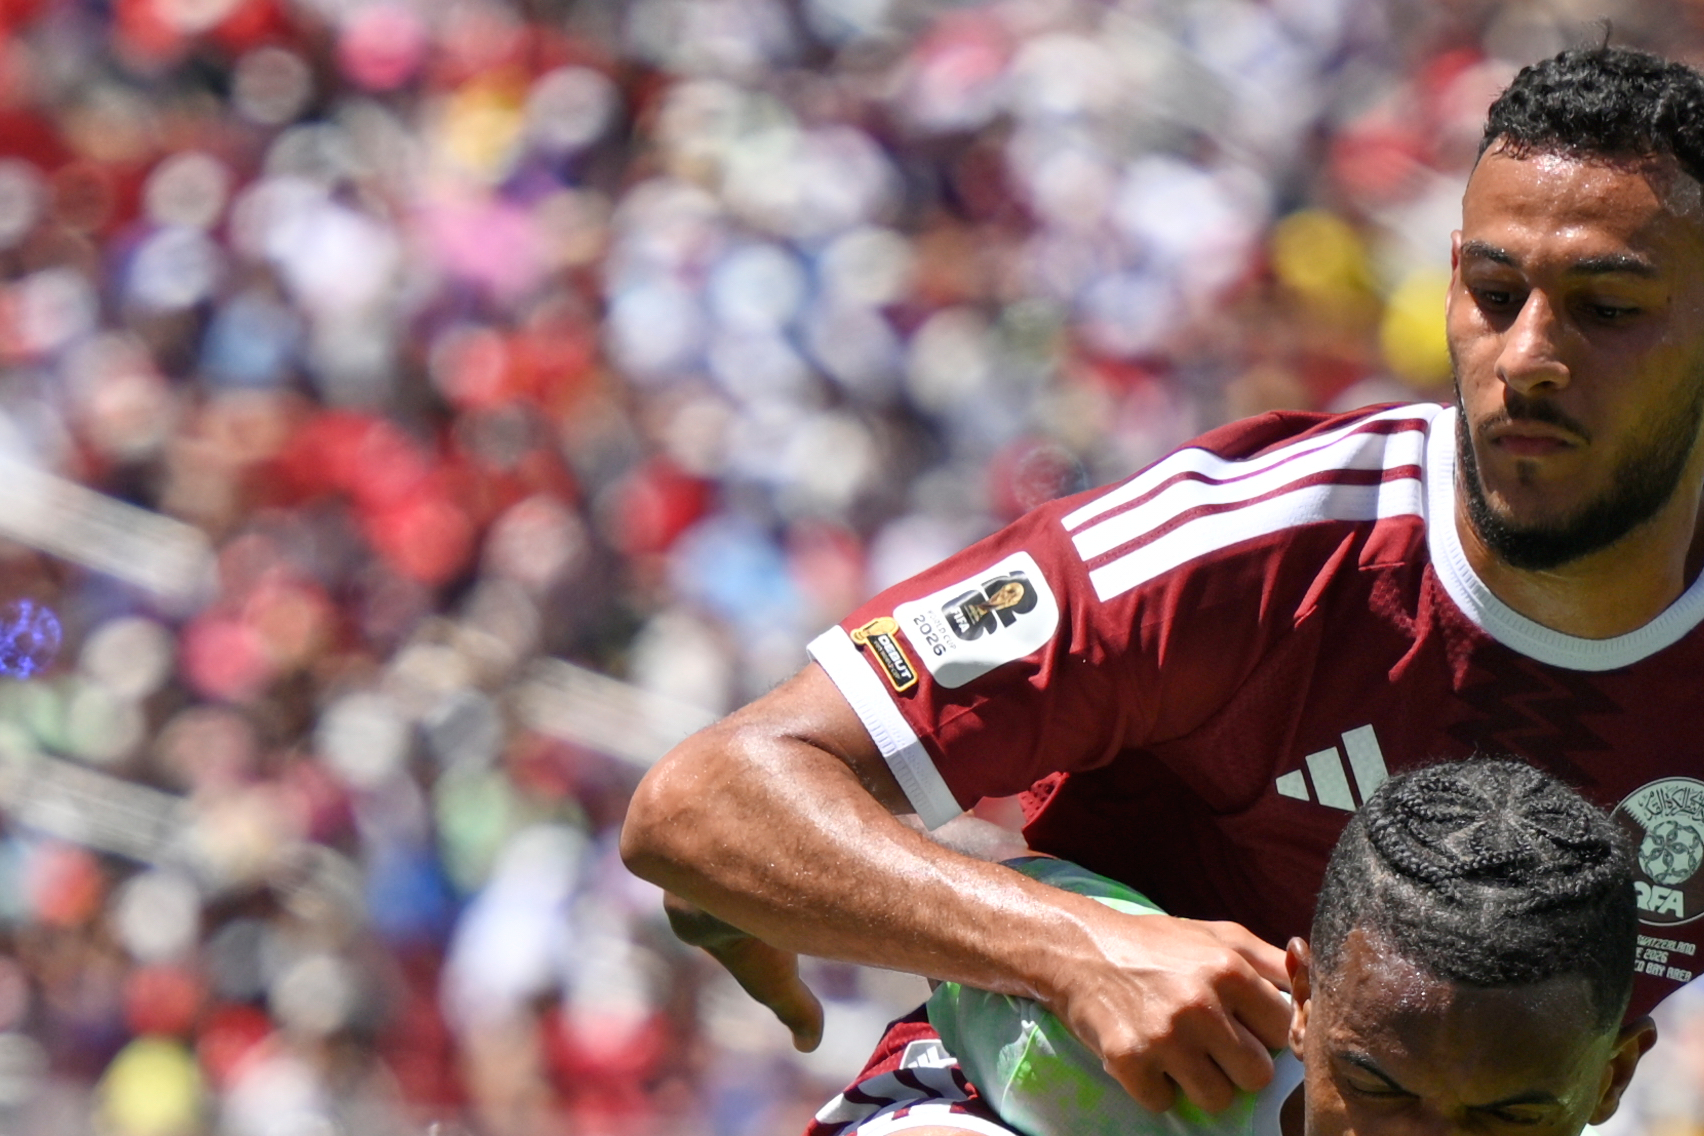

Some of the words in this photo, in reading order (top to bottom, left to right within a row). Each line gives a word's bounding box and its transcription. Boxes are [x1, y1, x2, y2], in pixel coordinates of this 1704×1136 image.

[951, 606, 971, 633] FIFA
[913, 614, 947, 656] 2026
[877, 634, 912, 679] DEBUT
[1643, 948, 1669, 963] 2026
[1646, 962, 1666, 977] BAY
